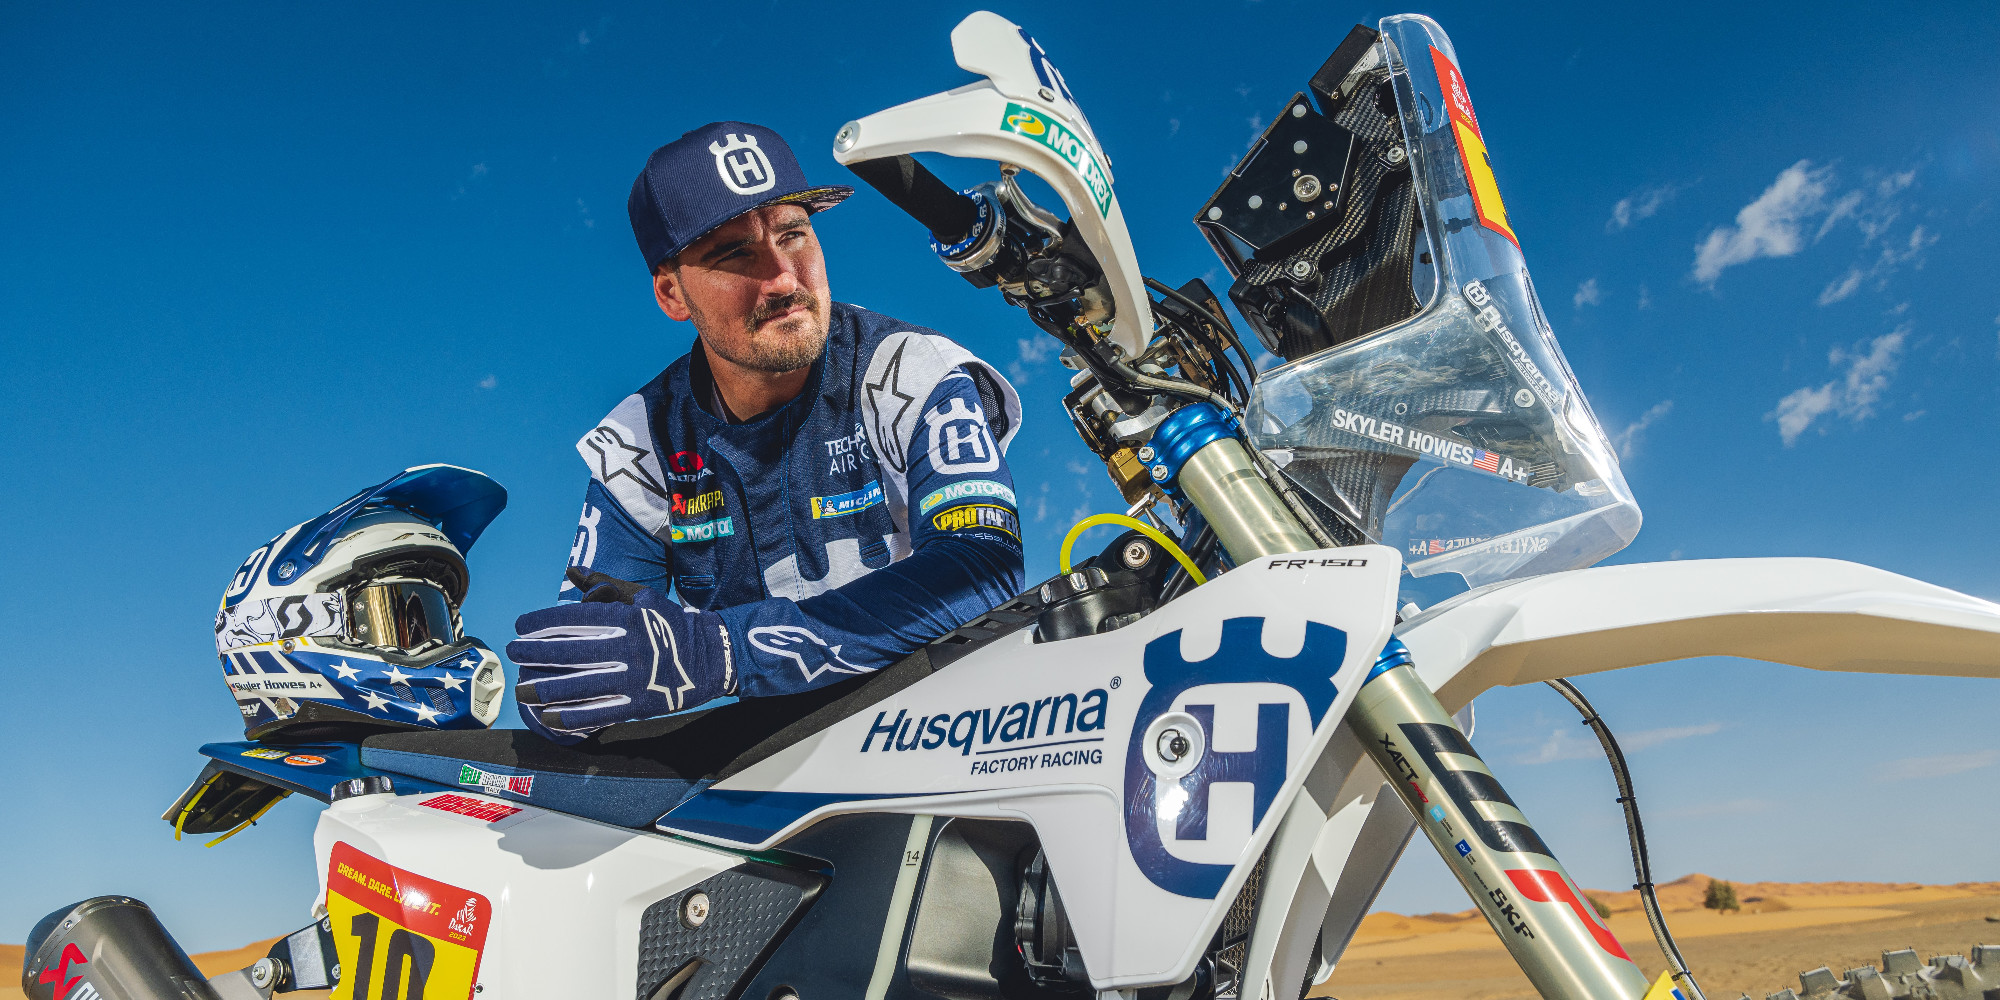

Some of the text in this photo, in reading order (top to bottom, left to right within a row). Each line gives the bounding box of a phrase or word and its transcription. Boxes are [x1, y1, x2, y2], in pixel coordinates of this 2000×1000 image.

[1046, 122, 1110, 213] MOTOREX
[1332, 408, 1528, 481] SKYLER HOWES A+
[1268, 558, 1368, 570] FR450
[233, 682, 260, 694] Skyler
[263, 680, 306, 690] Howes
[860, 688, 1109, 756] Husqvarna
[970, 749, 1103, 775] FACTORY RACING
[1378, 732, 1419, 781] XACT
[508, 776, 533, 796] VALLE
[906, 850, 919, 862] 14
[337, 862, 367, 887] DREAM.
[367, 877, 393, 900] DARE.
[1489, 888, 1535, 939] SKF
[351, 912, 436, 1000] 10
